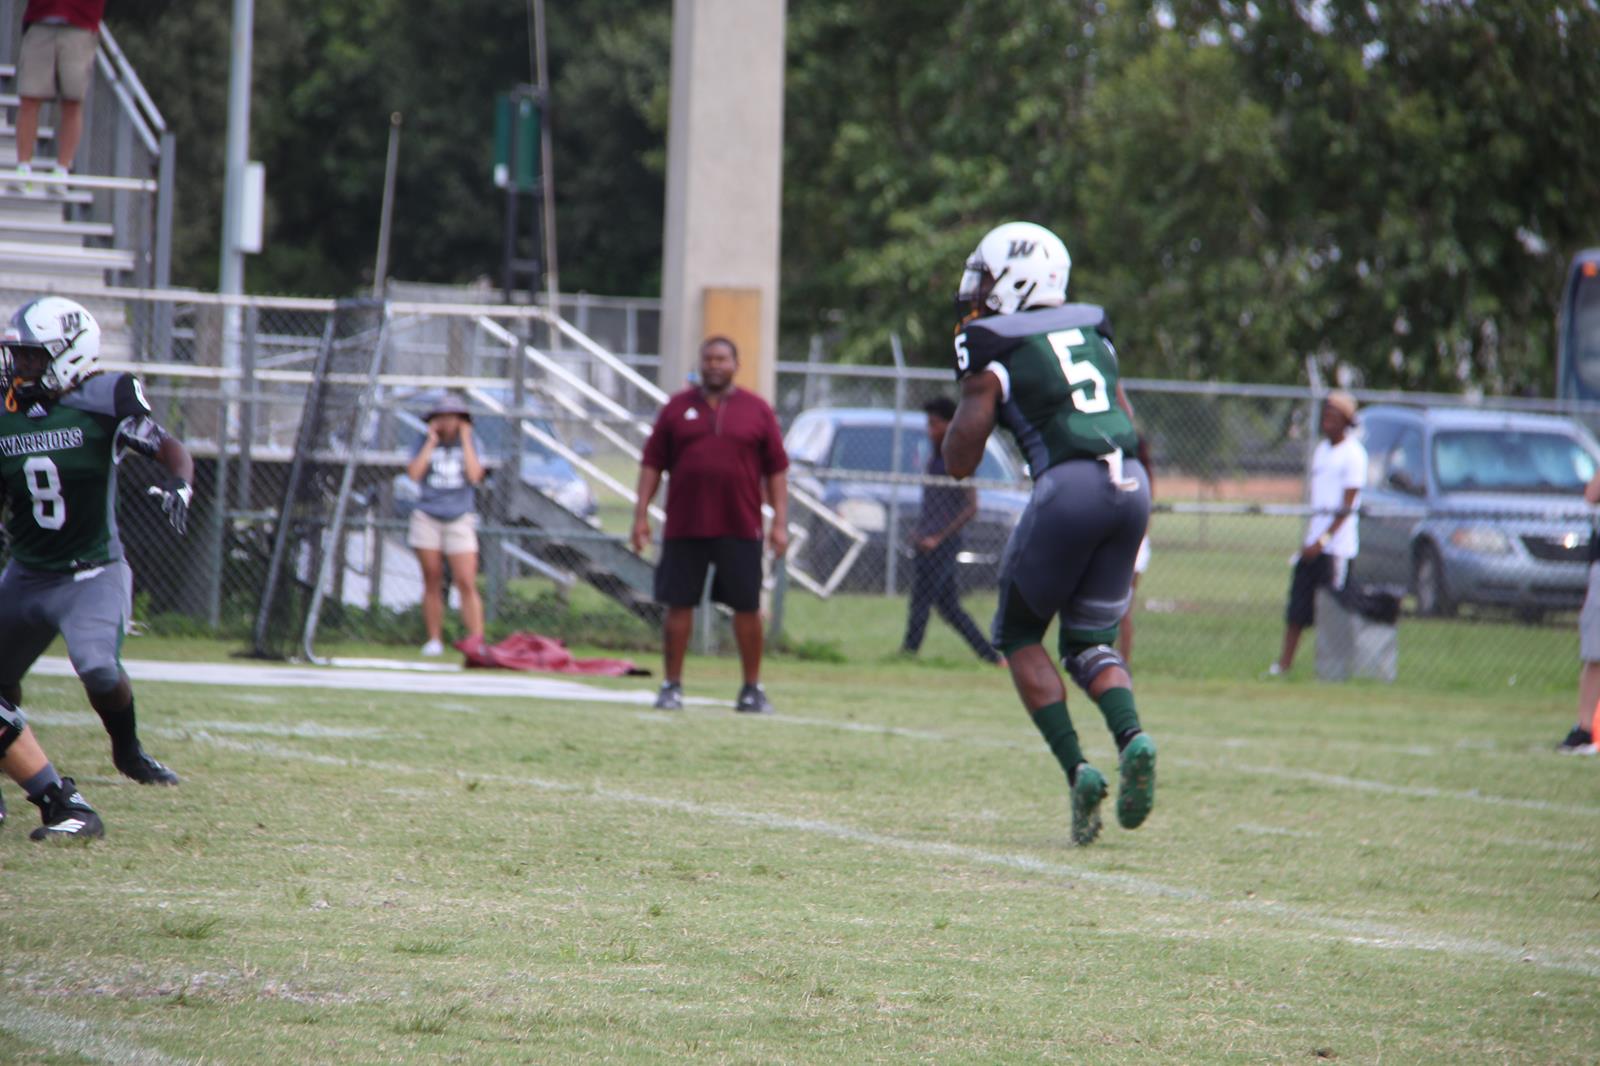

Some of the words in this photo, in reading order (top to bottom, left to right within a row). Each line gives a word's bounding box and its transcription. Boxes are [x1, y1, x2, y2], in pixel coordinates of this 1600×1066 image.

[1007, 240, 1036, 259] W
[60, 312, 80, 333] W
[954, 333, 969, 370] 5
[1047, 328, 1110, 413] 5
[0, 427, 83, 456] WARRIORS
[23, 456, 66, 530] 8
